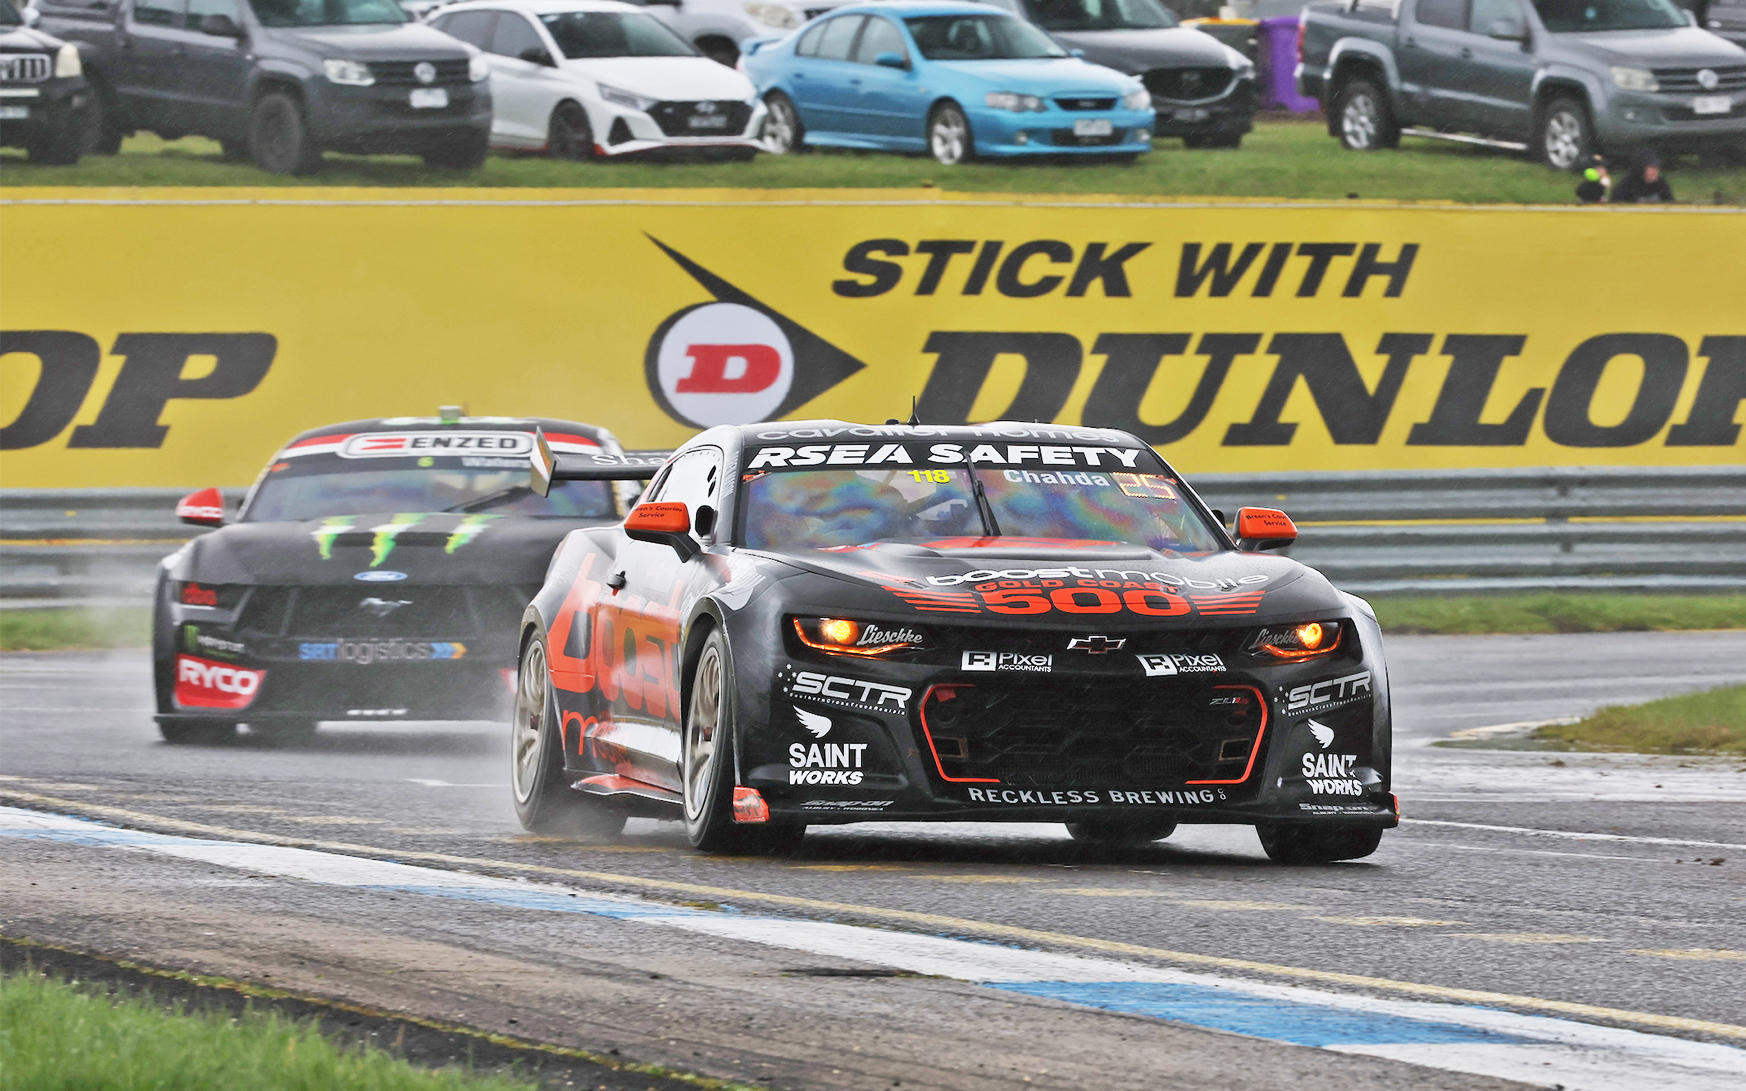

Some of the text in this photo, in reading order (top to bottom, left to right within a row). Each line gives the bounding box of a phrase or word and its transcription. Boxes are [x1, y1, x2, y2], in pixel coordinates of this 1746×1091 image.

[832, 239, 1420, 298] STICK WITH
[675, 344, 781, 394] D
[411, 436, 518, 449] ENZED
[747, 443, 1140, 469] RSEA SAFETY
[907, 469, 951, 484] 118
[1003, 469, 1111, 487] Chahda
[1113, 472, 1176, 500] 25
[974, 579, 1181, 594] GOLD COAST
[977, 586, 1193, 617] 500
[856, 624, 923, 646] Lieschke
[997, 664, 1053, 673] ACCOUNTANTS
[998, 652, 1053, 667] Pixel
[1169, 653, 1223, 667] Pixel
[179, 659, 259, 695] RYCO
[791, 671, 912, 708] SCTR
[1288, 670, 1371, 710] SCTR
[789, 742, 867, 768] SAINT
[1302, 752, 1358, 778] SAINT
[788, 770, 864, 785] WORKS
[1306, 779, 1363, 797] WORKS
[967, 787, 1099, 805] RECKLESS
[1108, 788, 1214, 805] BREWING
